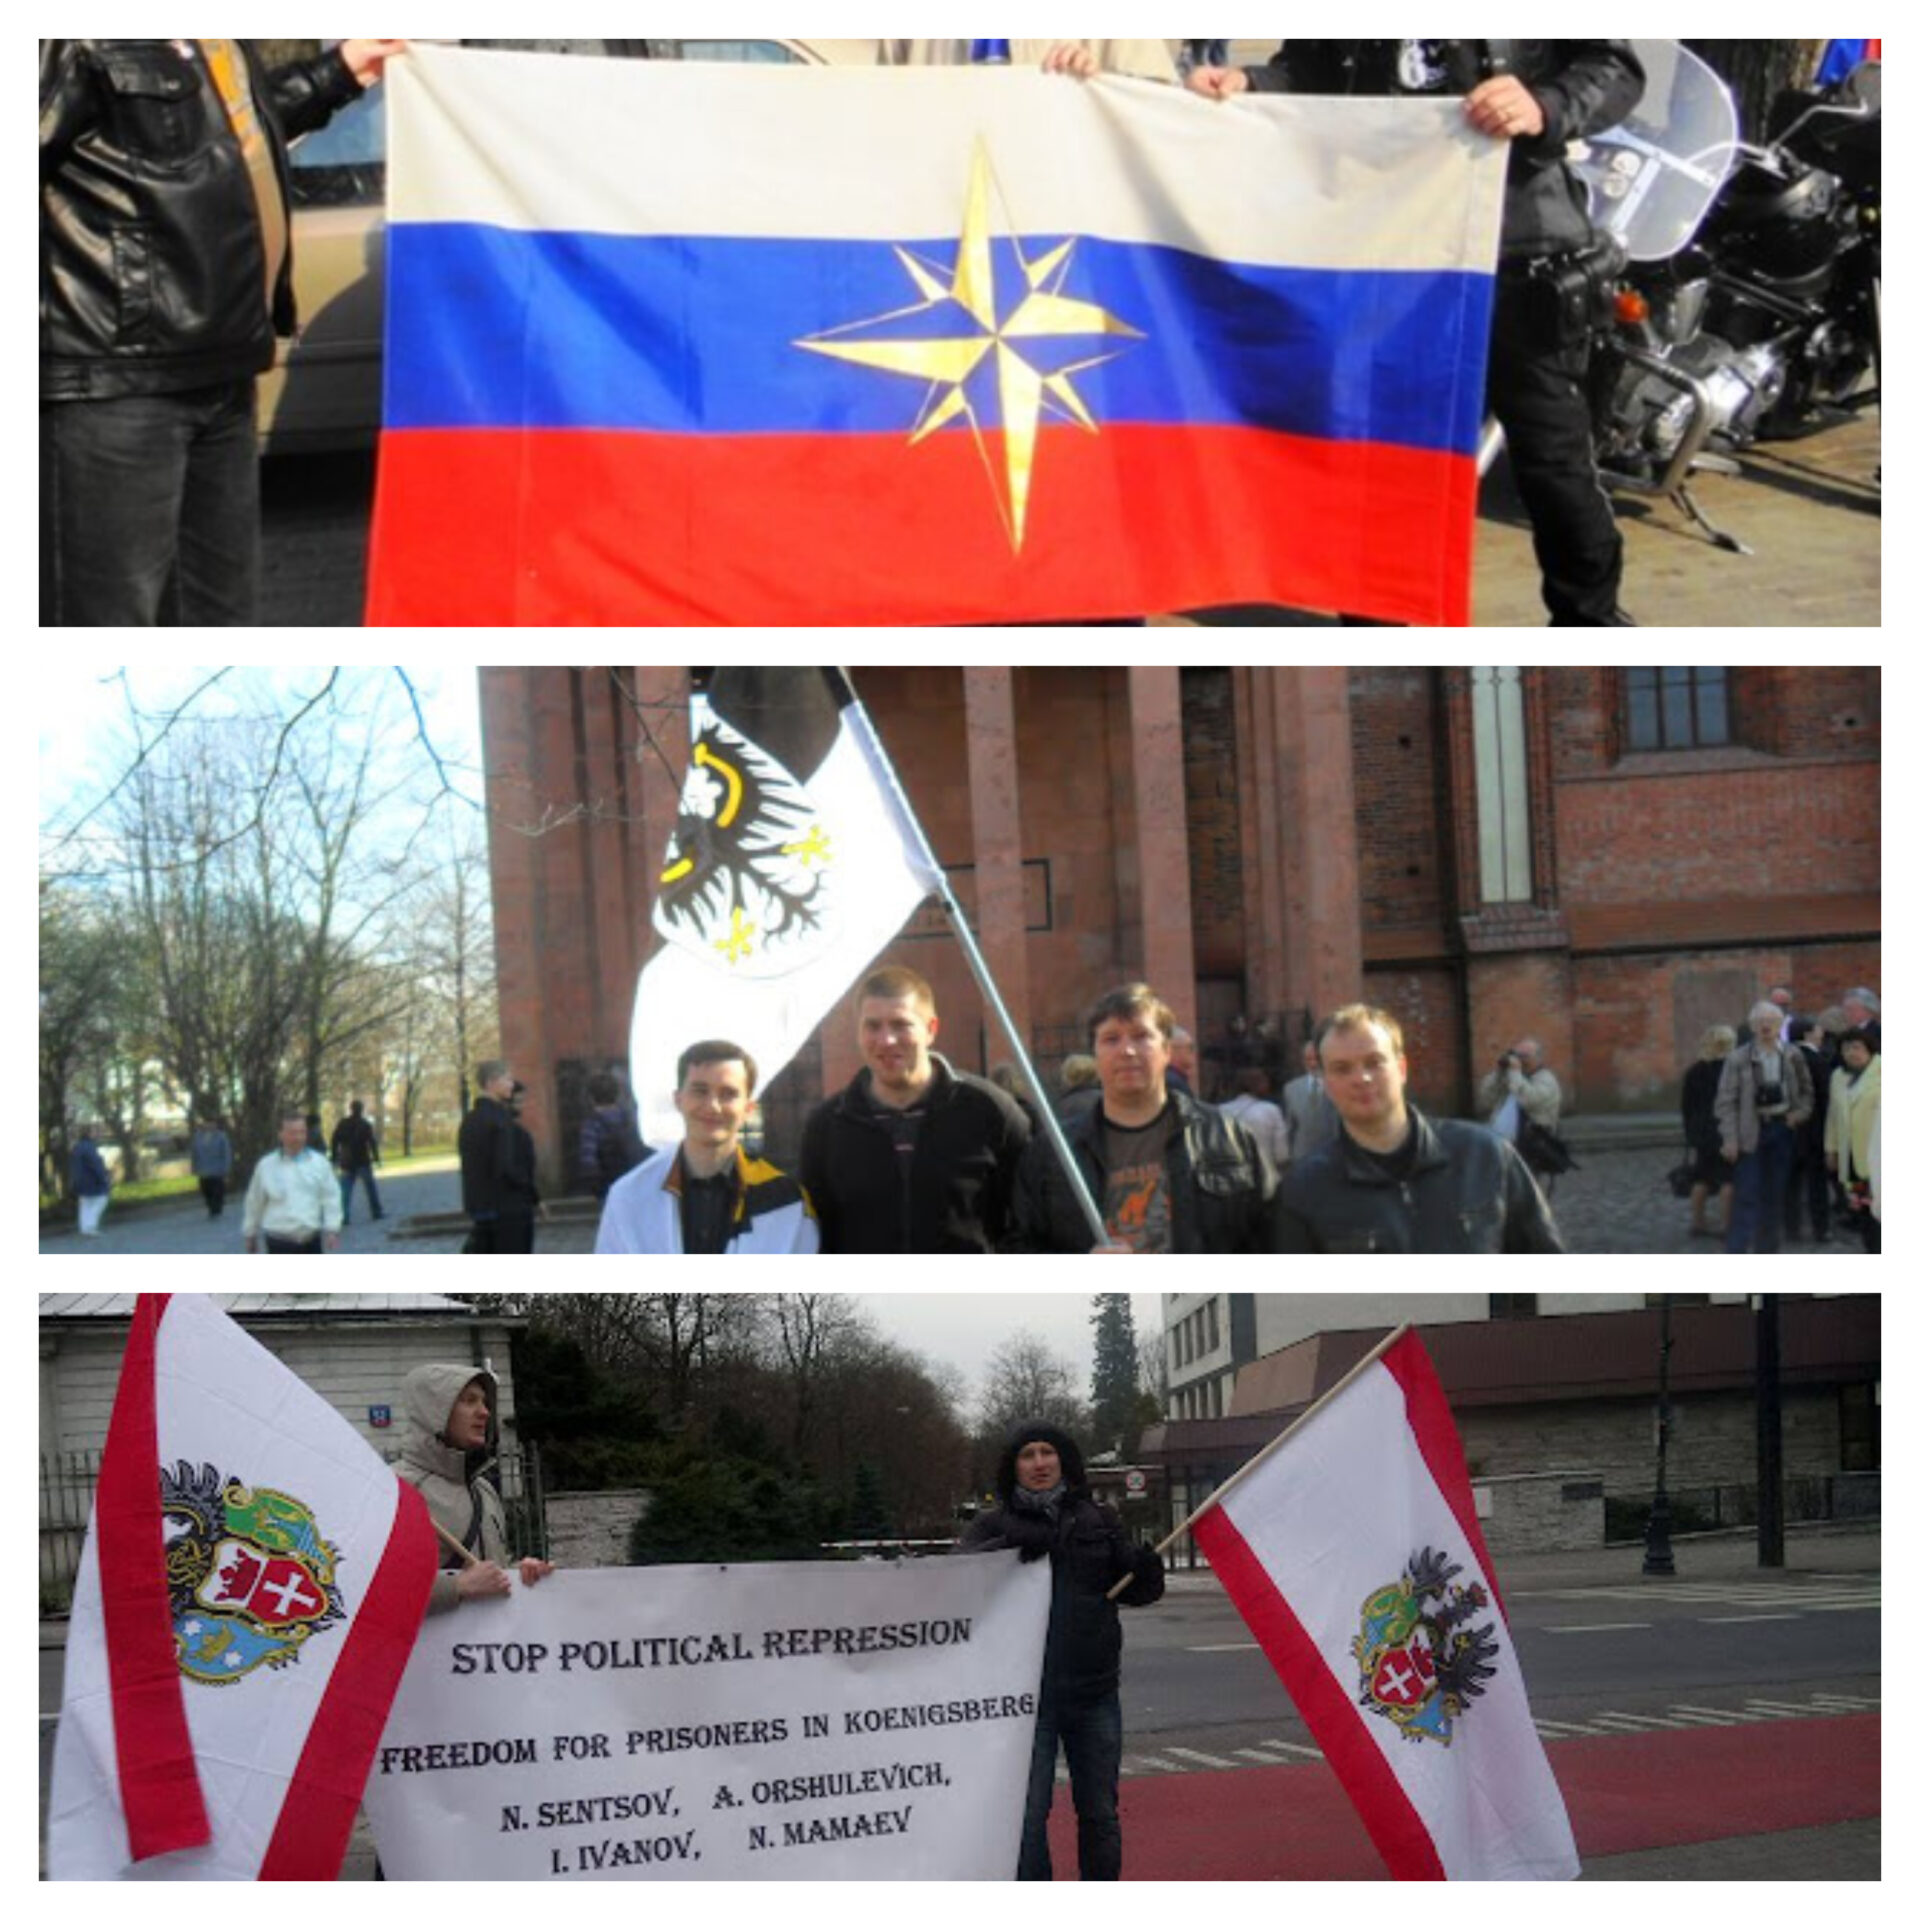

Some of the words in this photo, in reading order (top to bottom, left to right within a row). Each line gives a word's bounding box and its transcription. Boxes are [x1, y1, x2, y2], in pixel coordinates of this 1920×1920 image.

[451, 1642, 549, 1675] STOP
[557, 1633, 754, 1672] POLITICAL
[762, 1617, 972, 1660] REPRESSION
[380, 1738, 538, 1774] FREEDOM
[553, 1733, 612, 1761] FOR
[625, 1718, 789, 1756] PRISONERS
[801, 1714, 829, 1739] IN
[843, 1693, 1035, 1735] KOENIGSBERG
[500, 1804, 529, 1833] N.
[536, 1786, 681, 1828] SENTSOV,
[711, 1784, 745, 1810] A.
[751, 1761, 952, 1805] ORSHULEVICH,
[551, 1848, 570, 1875] I.
[578, 1828, 702, 1872] IVANOV,
[748, 1825, 776, 1851] N.
[782, 1806, 913, 1847] MAMAEV
